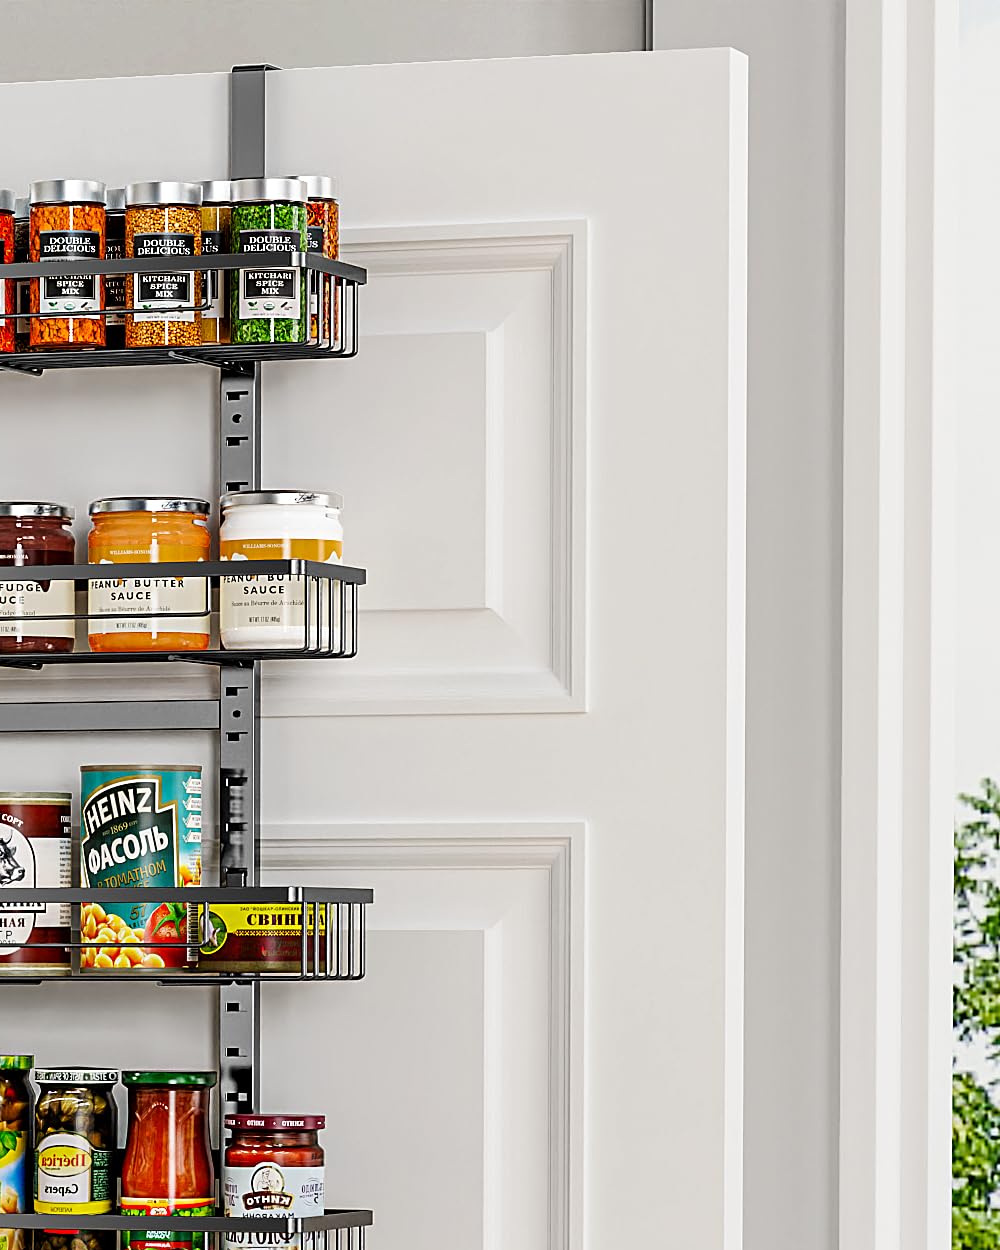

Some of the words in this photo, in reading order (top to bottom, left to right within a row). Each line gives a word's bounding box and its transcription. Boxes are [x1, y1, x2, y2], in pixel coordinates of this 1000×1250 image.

[49, 237, 91, 245] DOUBLE
[143, 239, 185, 247] DOUBLE
[249, 236, 292, 244] DOUBLE
[43, 245, 96, 253] DELICIOUS
[137, 247, 191, 255] DELICIOUS
[243, 244, 297, 252] DELICIOUS
[142, 275, 186, 283] KITCHARI
[248, 272, 292, 280] KITCHARI
[155, 290, 174, 298] MIX
[261, 287, 279, 295] MIX
[0, 583, 41, 592] FUDGE
[91, 579, 128, 589] PEANUT
[134, 579, 184, 588] BUTTER
[243, 586, 285, 595] SAUCE
[111, 591, 152, 601] SAUCE
[86, 787, 152, 834] HEINZ
[2, 813, 24, 828] СОРТ
[110, 821, 128, 835] 1869
[88, 825, 169, 875] ФАСОЛЬ
[104, 859, 167, 888] ТОМАТНОМ
